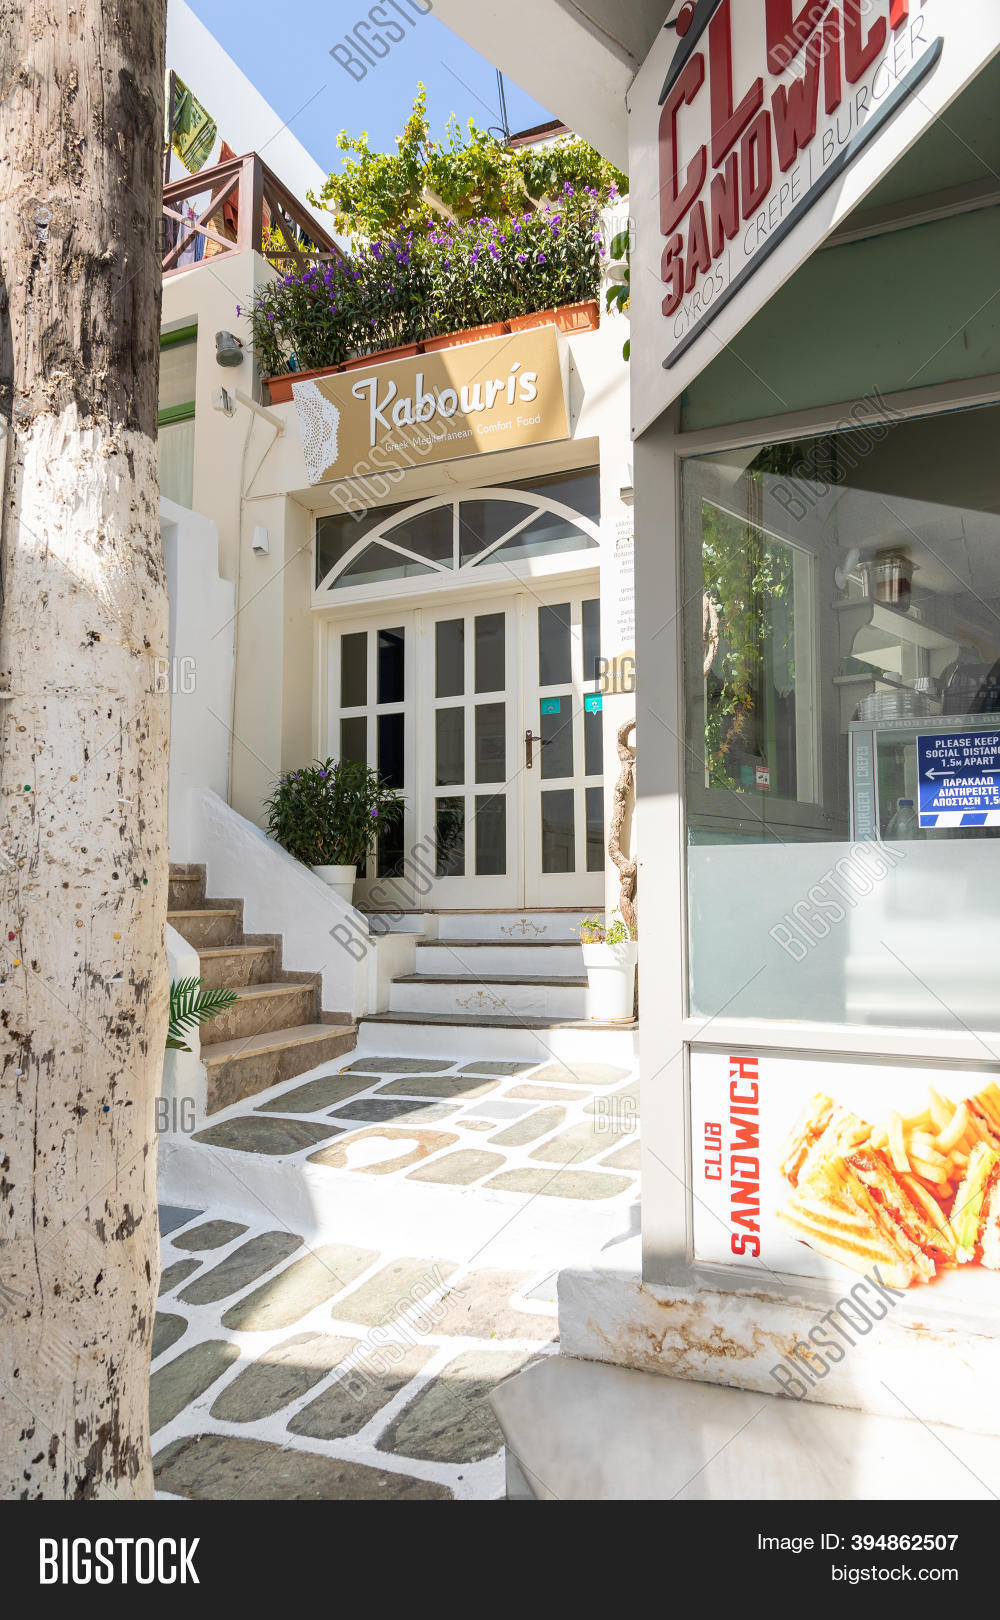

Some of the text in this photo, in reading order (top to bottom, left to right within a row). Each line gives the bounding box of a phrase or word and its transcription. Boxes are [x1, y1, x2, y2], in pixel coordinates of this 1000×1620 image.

[743, 165, 801, 256] CREPE
[821, 14, 928, 167] BURGER
[661, 0, 908, 317] SANDWIC
[385, 413, 541, 452] Greek Mediterranean Comfort Food
[926, 749, 960, 758] SOCIAL
[935, 736, 999, 749] PLEASE KEEP
[964, 756, 995, 766] APART
[938, 786, 999, 797] ΔΙΑΤΗΡΕΙΣΤΕ
[943, 776, 994, 787] ΠΑΡΑΚΑΛΩ
[858, 792, 871, 834] BURGER
[932, 796, 981, 807] ΑΠΟΣΤΑΣΗ
[704, 1121, 722, 1181] CLUB
[729, 1056, 760, 1258] SANDWICH
